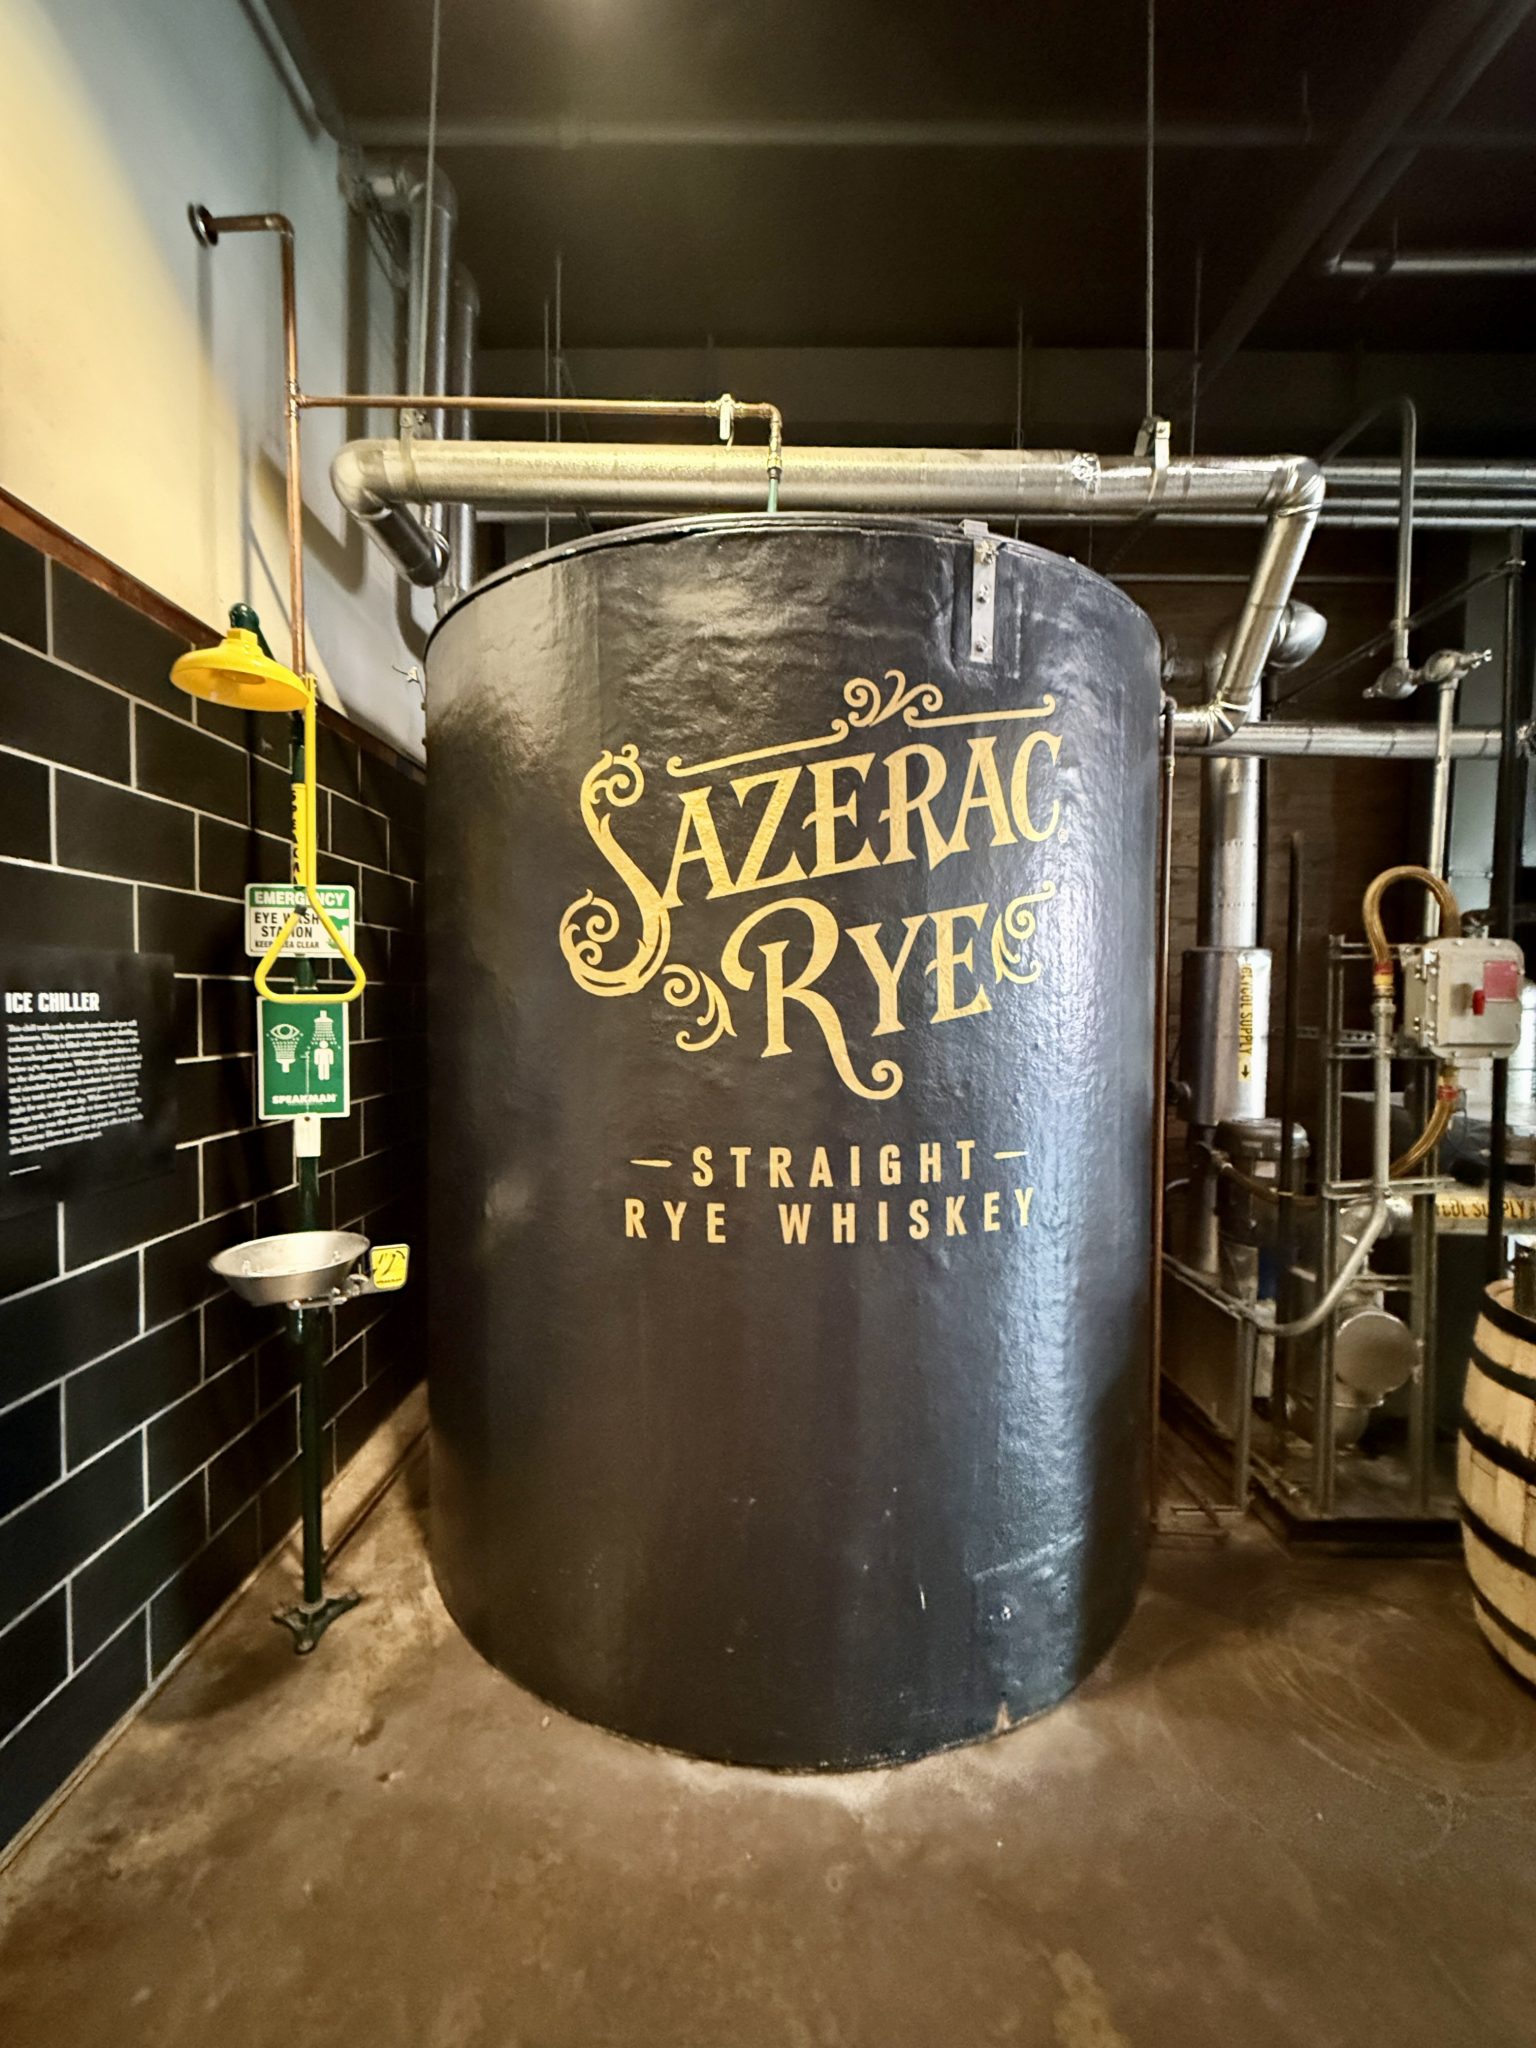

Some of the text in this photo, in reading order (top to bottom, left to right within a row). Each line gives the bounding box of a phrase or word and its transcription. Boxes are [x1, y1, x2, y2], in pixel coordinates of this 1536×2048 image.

[559, 730, 1064, 997] SAZERAC
[254, 912, 319, 925] EYE WSH
[261, 925, 313, 938] STAION
[296, 941, 319, 949] CLEAR
[4, 992, 101, 1014] ICE CHILLER
[720, 896, 992, 1100] RYE
[1240, 966, 1253, 1055] GLYCOL SUPPLY
[271, 1093, 337, 1105] SPEAKMAN
[691, 1139, 977, 1189] STRAIGHT
[624, 1186, 1035, 1245] RYE WHISKEY
[1471, 1199, 1525, 1219] SUPLY
